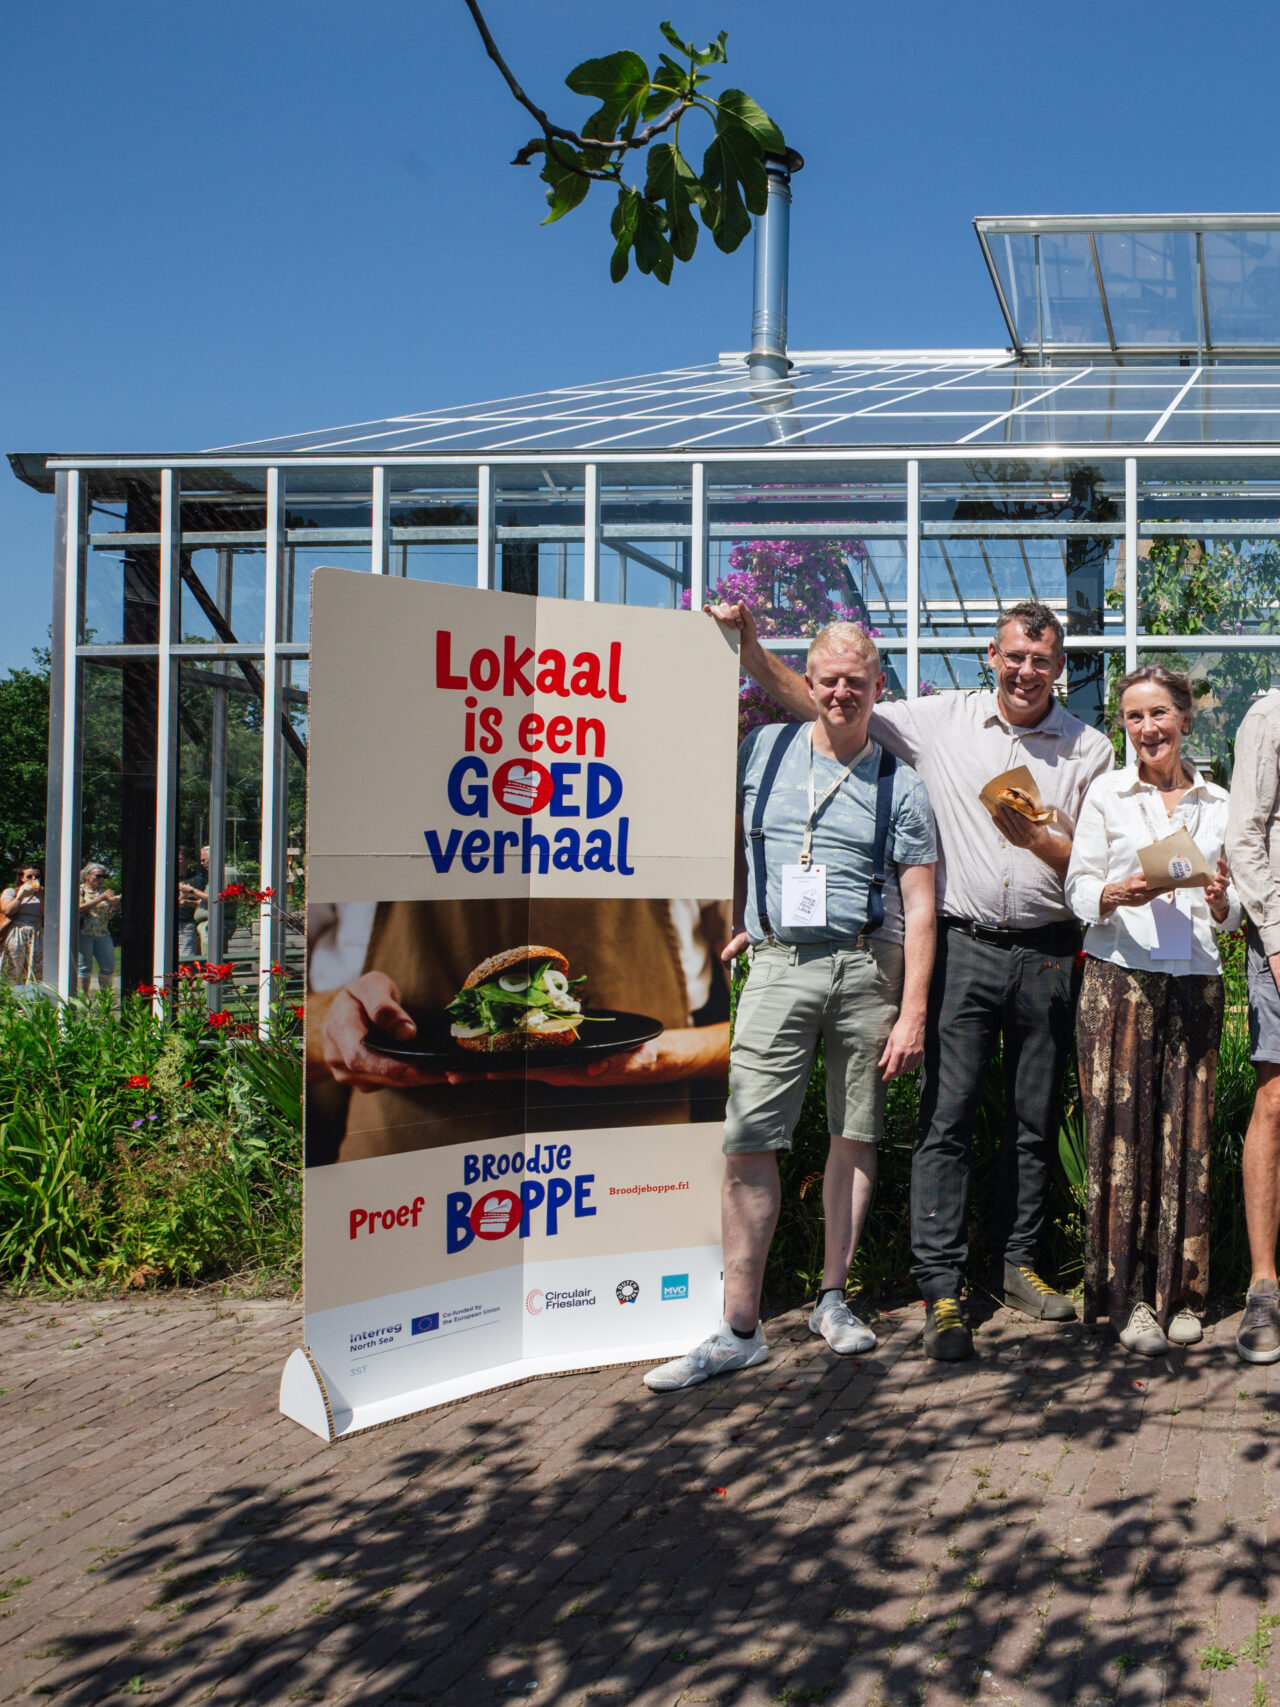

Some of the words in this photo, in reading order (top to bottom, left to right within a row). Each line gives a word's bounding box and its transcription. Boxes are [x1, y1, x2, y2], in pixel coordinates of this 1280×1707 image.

[436, 630, 627, 703] Lokaal
[464, 696, 503, 754] is
[518, 712, 606, 757] een
[424, 817, 635, 875] verhaal
[609, 1181, 689, 1195] Broodjeboppe.frl
[349, 1197, 425, 1240] Proef
[545, 1288, 592, 1301] Circulair
[664, 1285, 686, 1295] MVO
[546, 1296, 596, 1310] Friesland
[350, 1323, 402, 1343] Interreg
[350, 1340, 377, 1352] North
[378, 1336, 394, 1345] Sea
